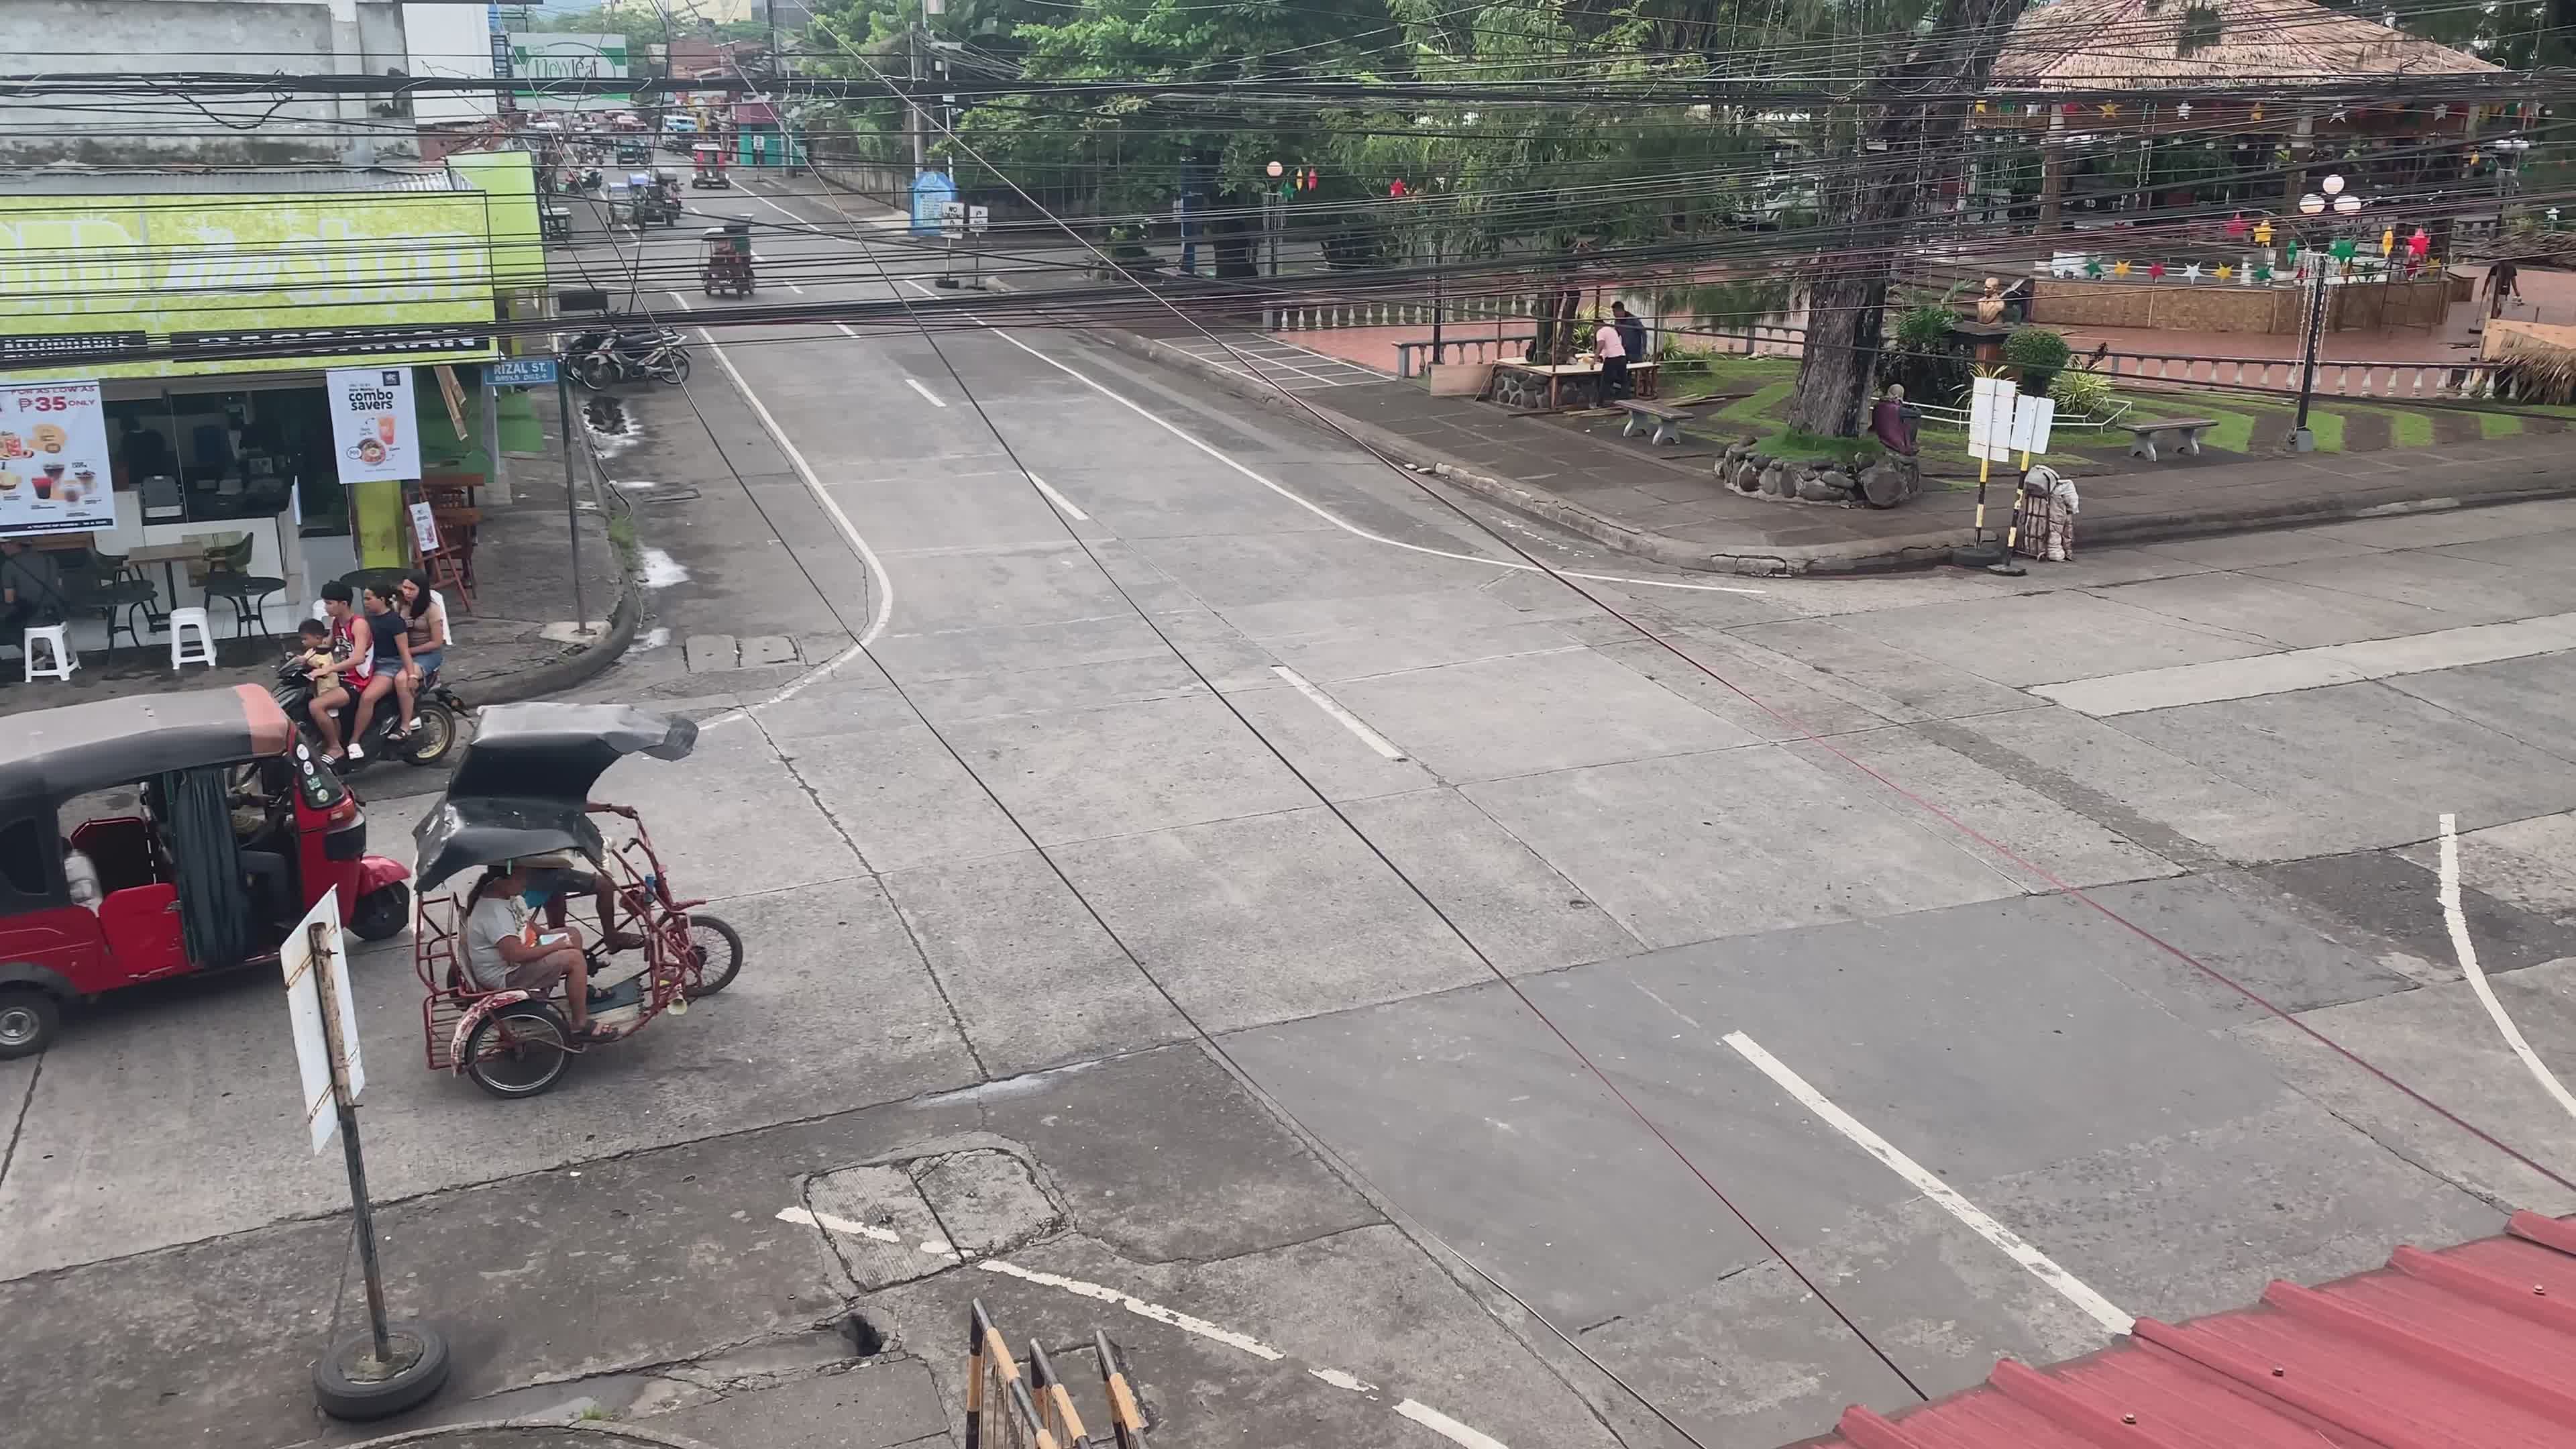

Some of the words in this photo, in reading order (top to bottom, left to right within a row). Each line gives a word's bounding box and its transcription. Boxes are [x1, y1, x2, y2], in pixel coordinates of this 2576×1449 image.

[494, 362, 528, 374] RIZAL
[531, 362, 547, 373] ST.
[349, 388, 393, 401] combo
[352, 400, 392, 411] savers
